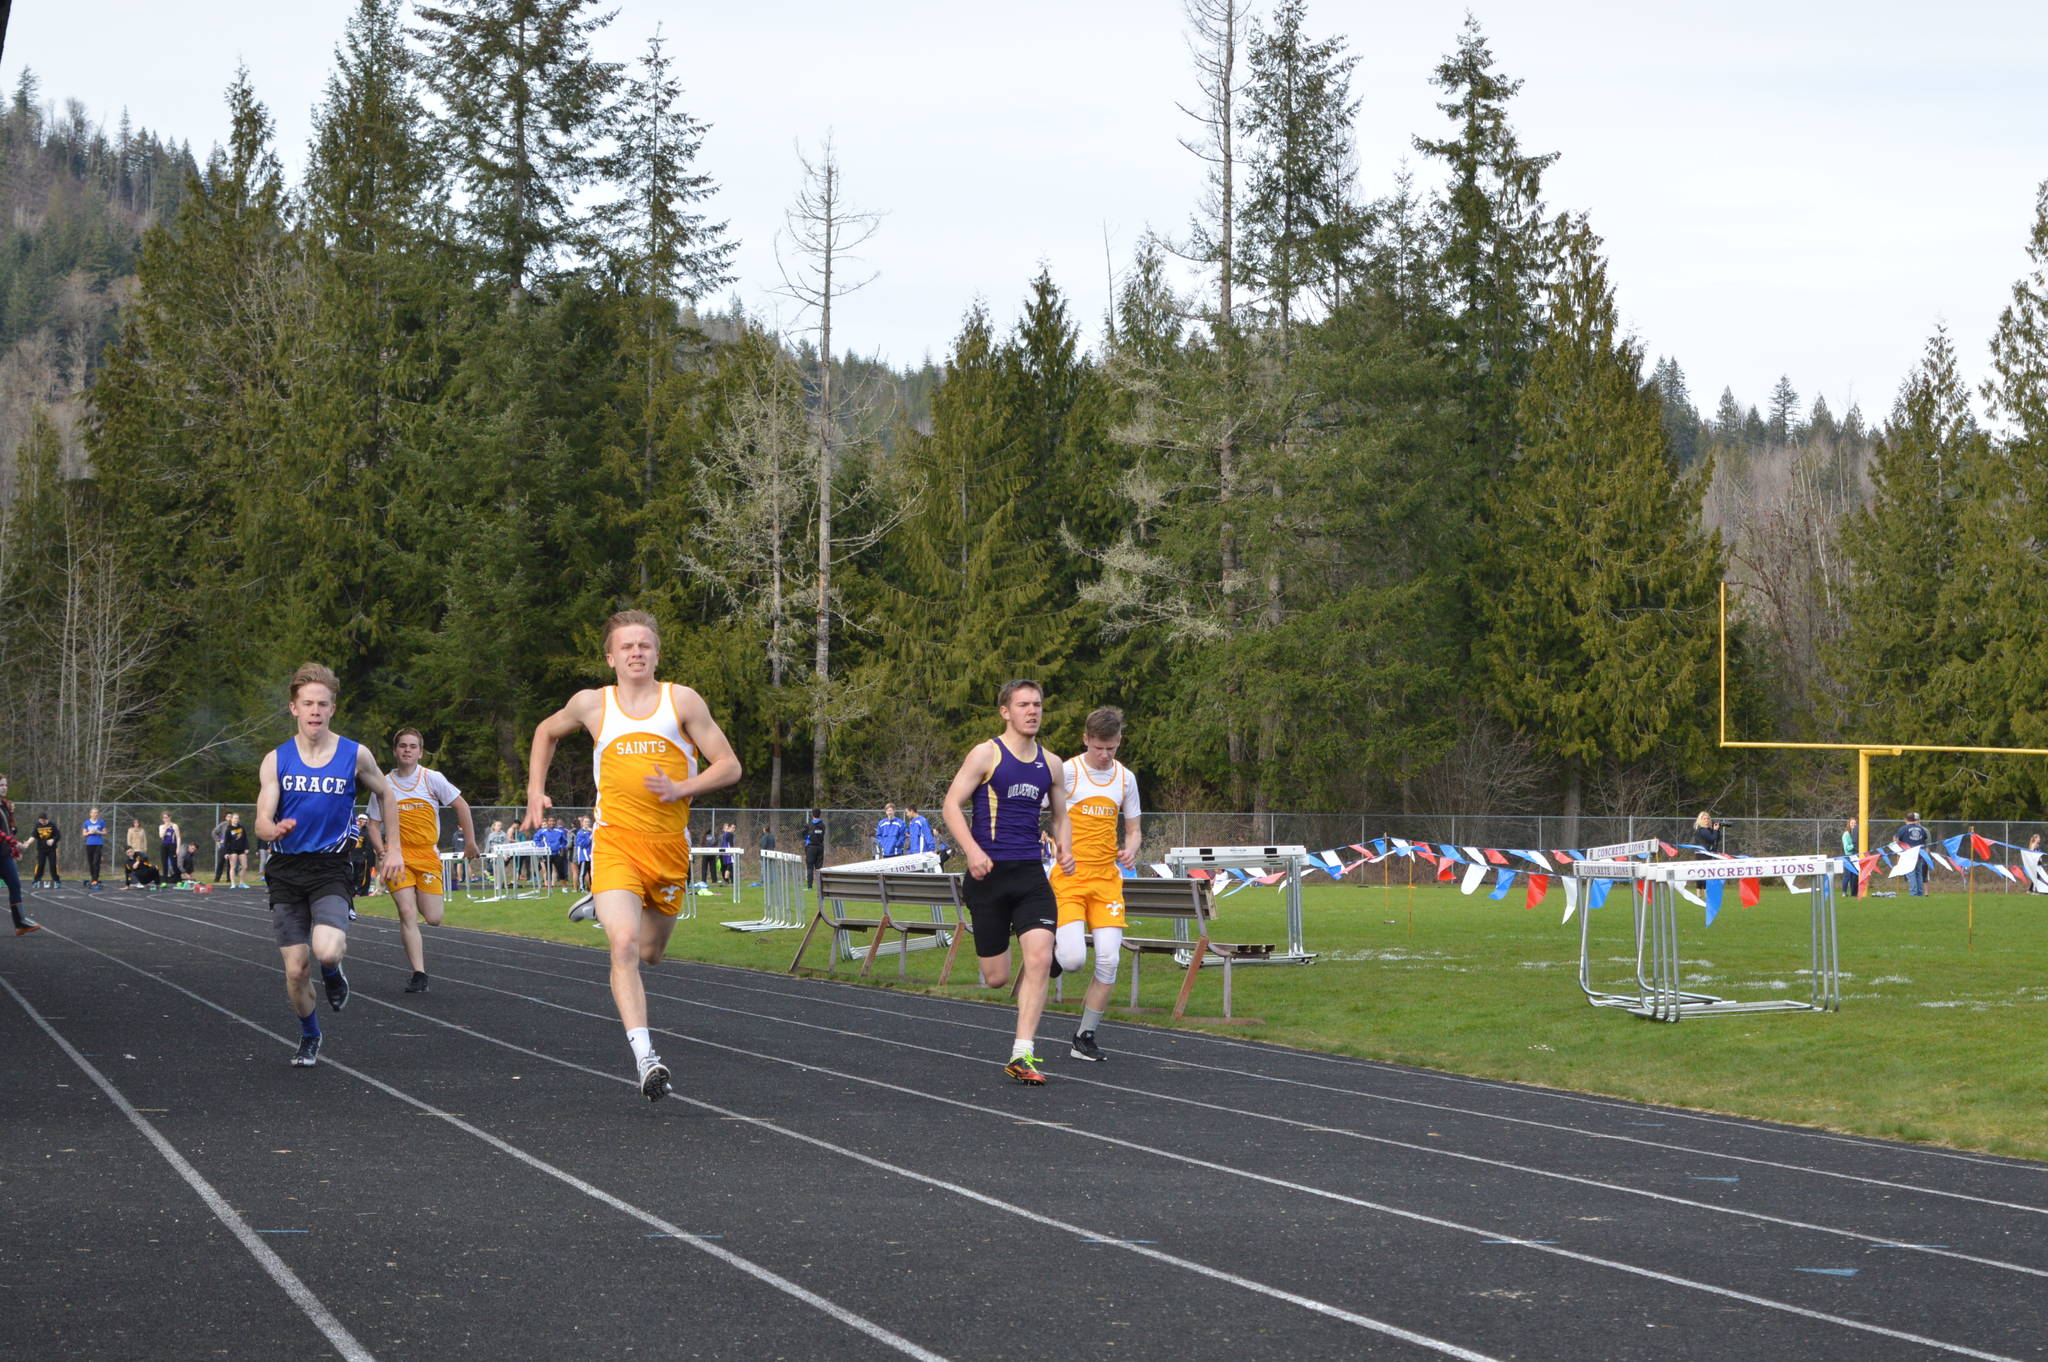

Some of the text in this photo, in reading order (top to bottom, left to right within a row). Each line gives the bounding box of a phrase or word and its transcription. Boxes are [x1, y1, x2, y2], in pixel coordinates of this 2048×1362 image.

[616, 741, 666, 755] SAINTS
[282, 775, 347, 795] GRACE
[1082, 805, 1115, 816] SAINTS
[1597, 842, 1645, 857] CONCRETE LIONS
[890, 864, 916, 873] LIONS
[1584, 866, 1610, 875] CONCRETE
[1687, 863, 1815, 878] CONCRETE LIONS
